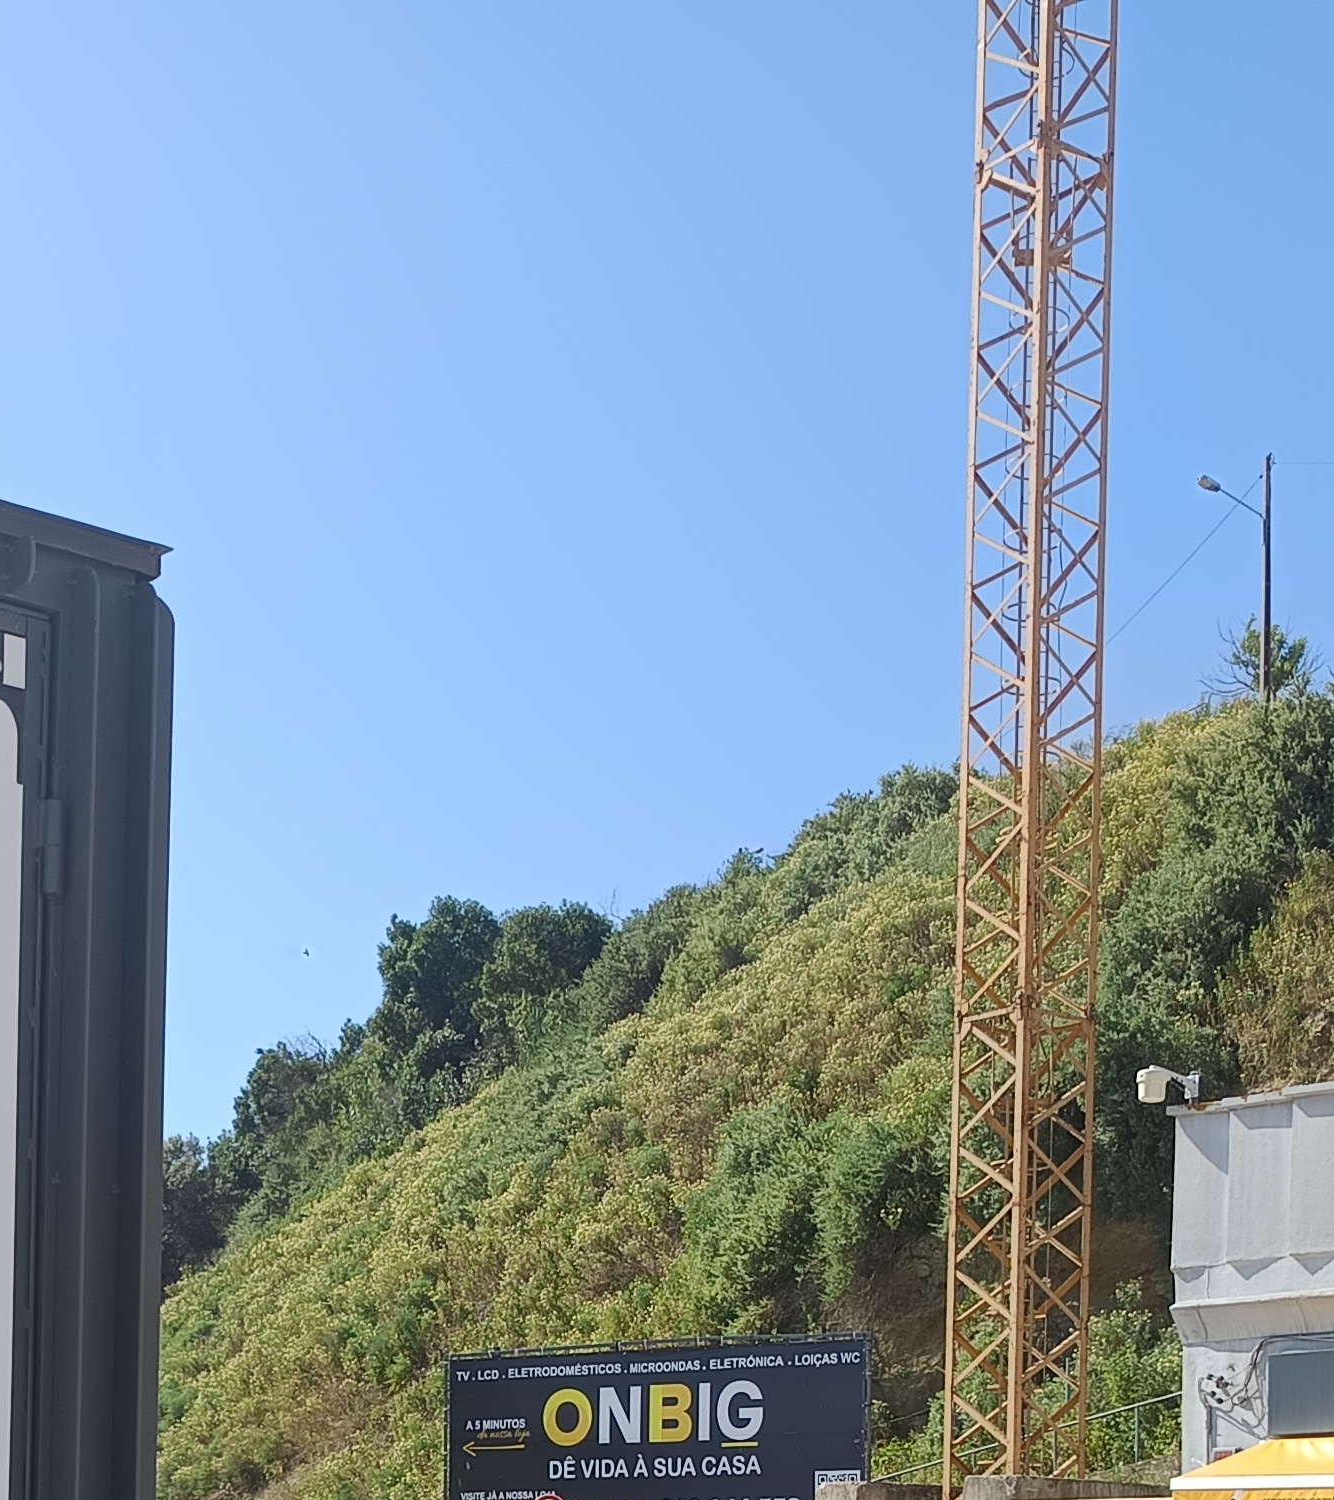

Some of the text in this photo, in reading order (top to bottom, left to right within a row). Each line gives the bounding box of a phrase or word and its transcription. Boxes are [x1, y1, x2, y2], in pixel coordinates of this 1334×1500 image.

[456, 1351, 861, 1381] TV LCD ELETRODOMÉSTICOS MICROONDAS ELETRÓNICA LOIÇAS WC
[466, 1418, 526, 1431] A 5 MINUTOS
[543, 1380, 763, 1447] ONBIG
[549, 1453, 762, 1479] DÊ VIDA À SUA CASA
[460, 1492, 485, 1500] VISITE
[487, 1490, 497, 1500] JÁ
[498, 1492, 504, 1500] A
[505, 1491, 534, 1500] NOSSA
